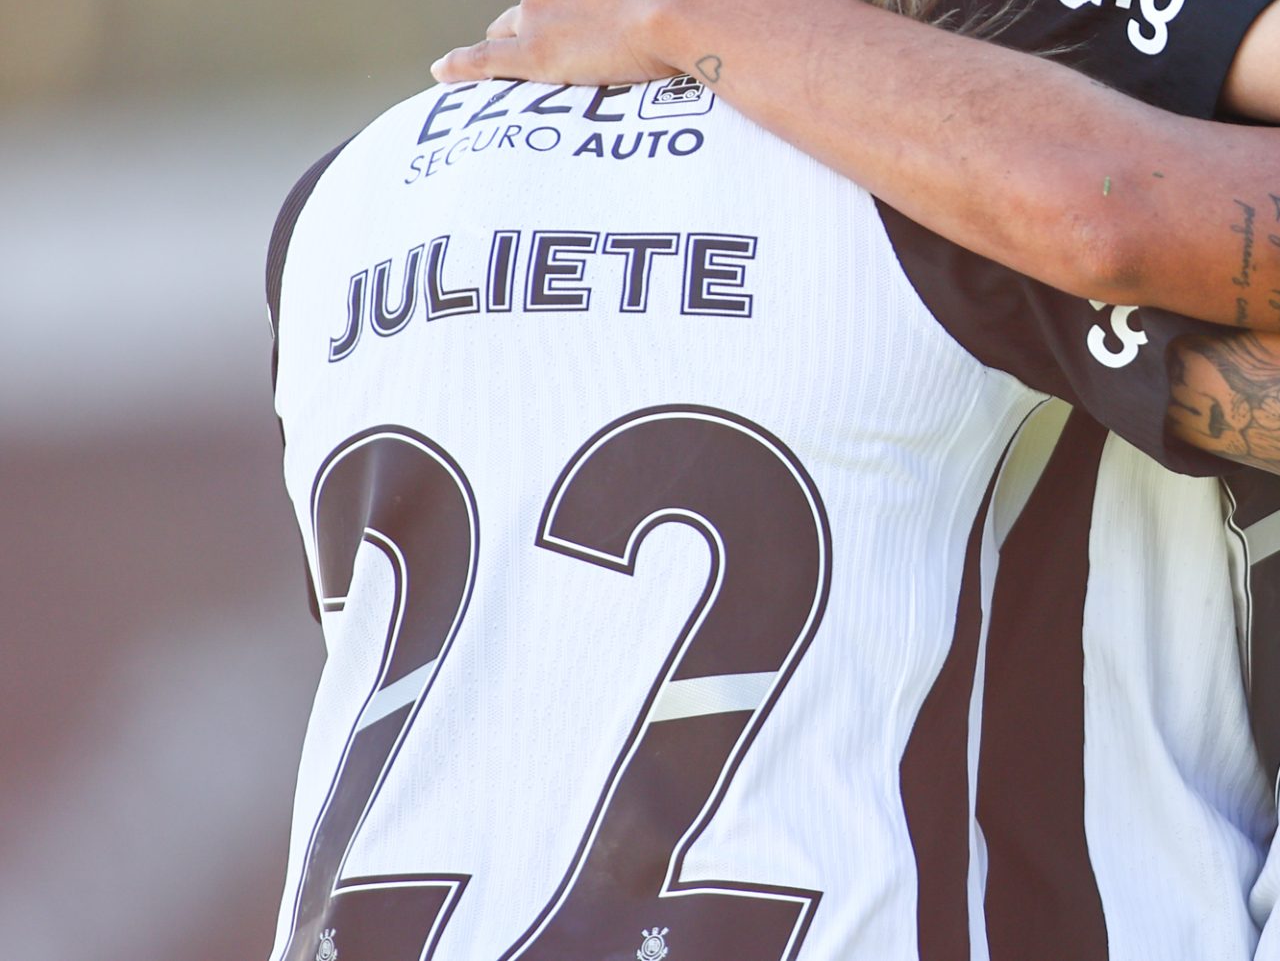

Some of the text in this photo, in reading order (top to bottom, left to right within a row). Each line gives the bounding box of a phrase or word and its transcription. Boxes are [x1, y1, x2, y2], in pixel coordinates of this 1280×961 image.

[404, 124, 705, 185] SEGURO AUTO
[327, 230, 759, 364] JULIETE
[276, 402, 834, 961] 22
